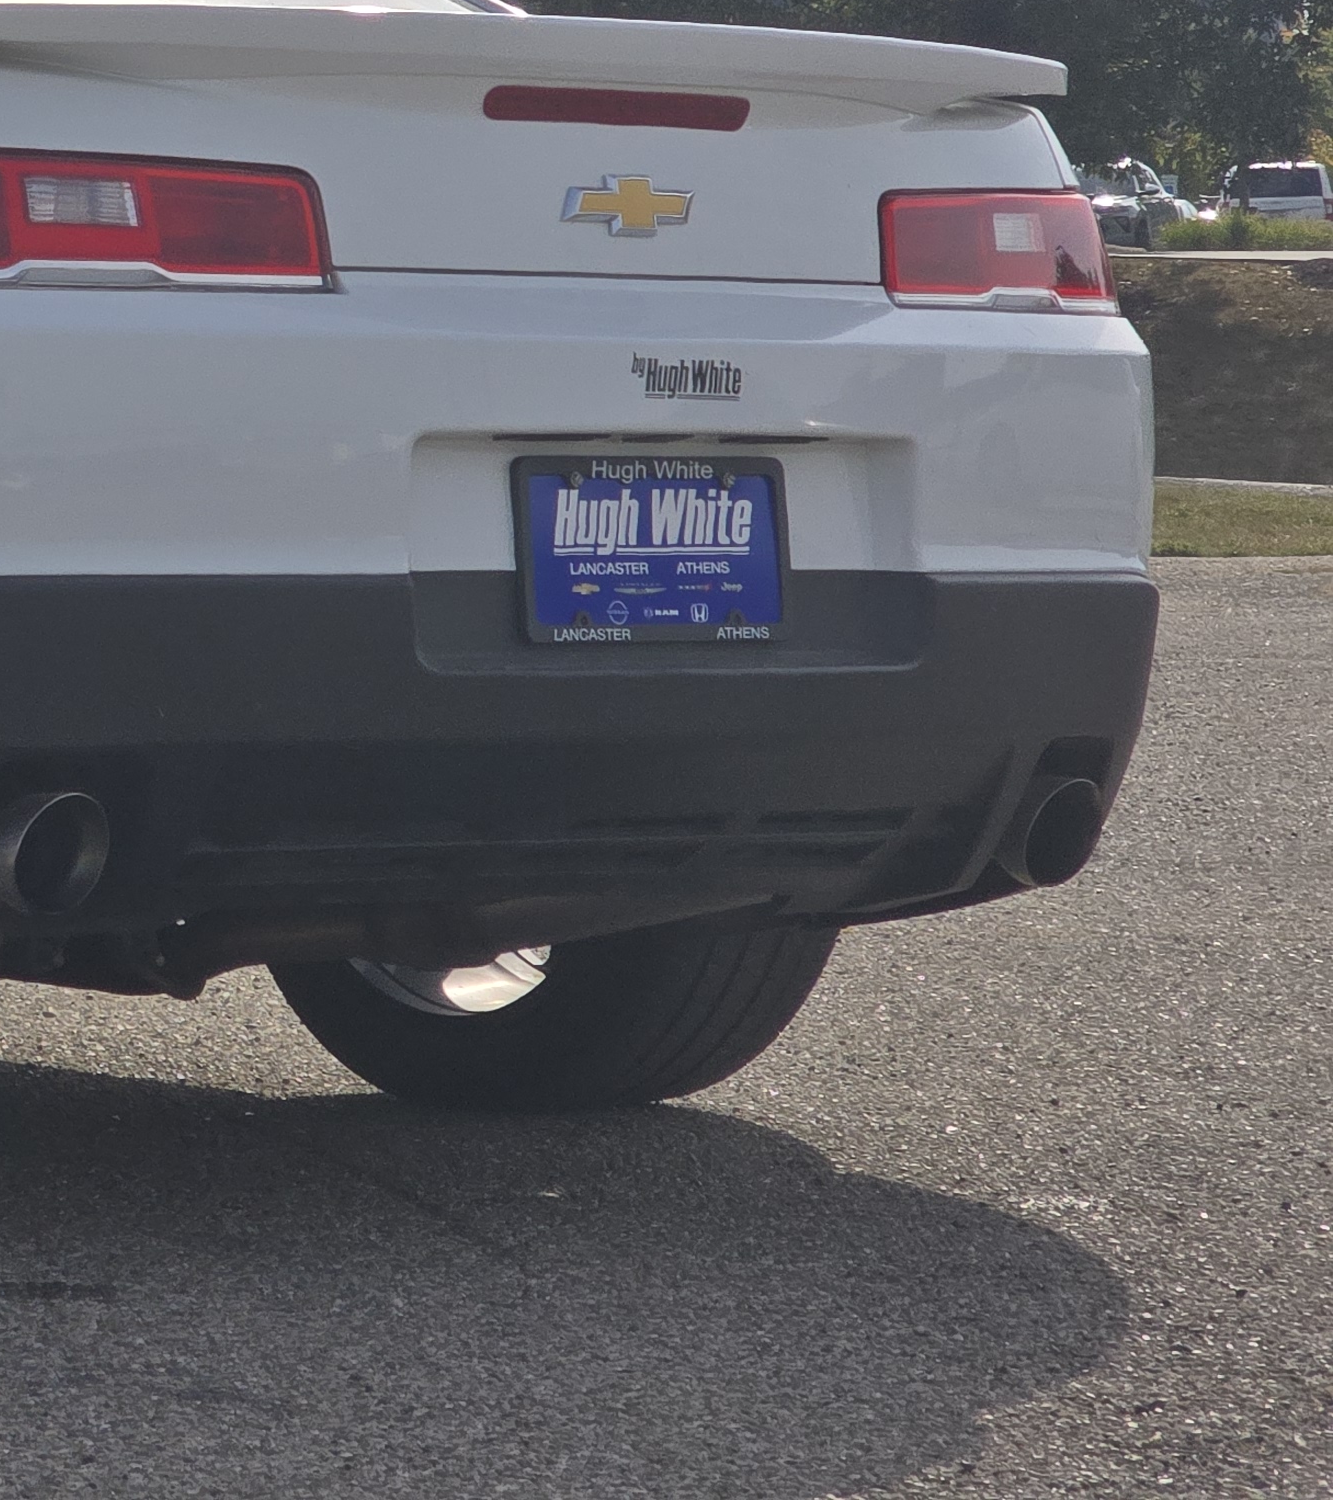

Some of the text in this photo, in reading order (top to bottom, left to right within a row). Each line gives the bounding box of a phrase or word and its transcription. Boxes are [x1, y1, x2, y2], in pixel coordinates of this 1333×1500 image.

[631, 351, 742, 399] by Hugh White
[591, 460, 714, 484] Hugh White
[554, 488, 753, 556] Hugh White
[569, 561, 730, 576] LANCASTER ATHENS
[553, 626, 770, 642] LANCASTER ATHENS
